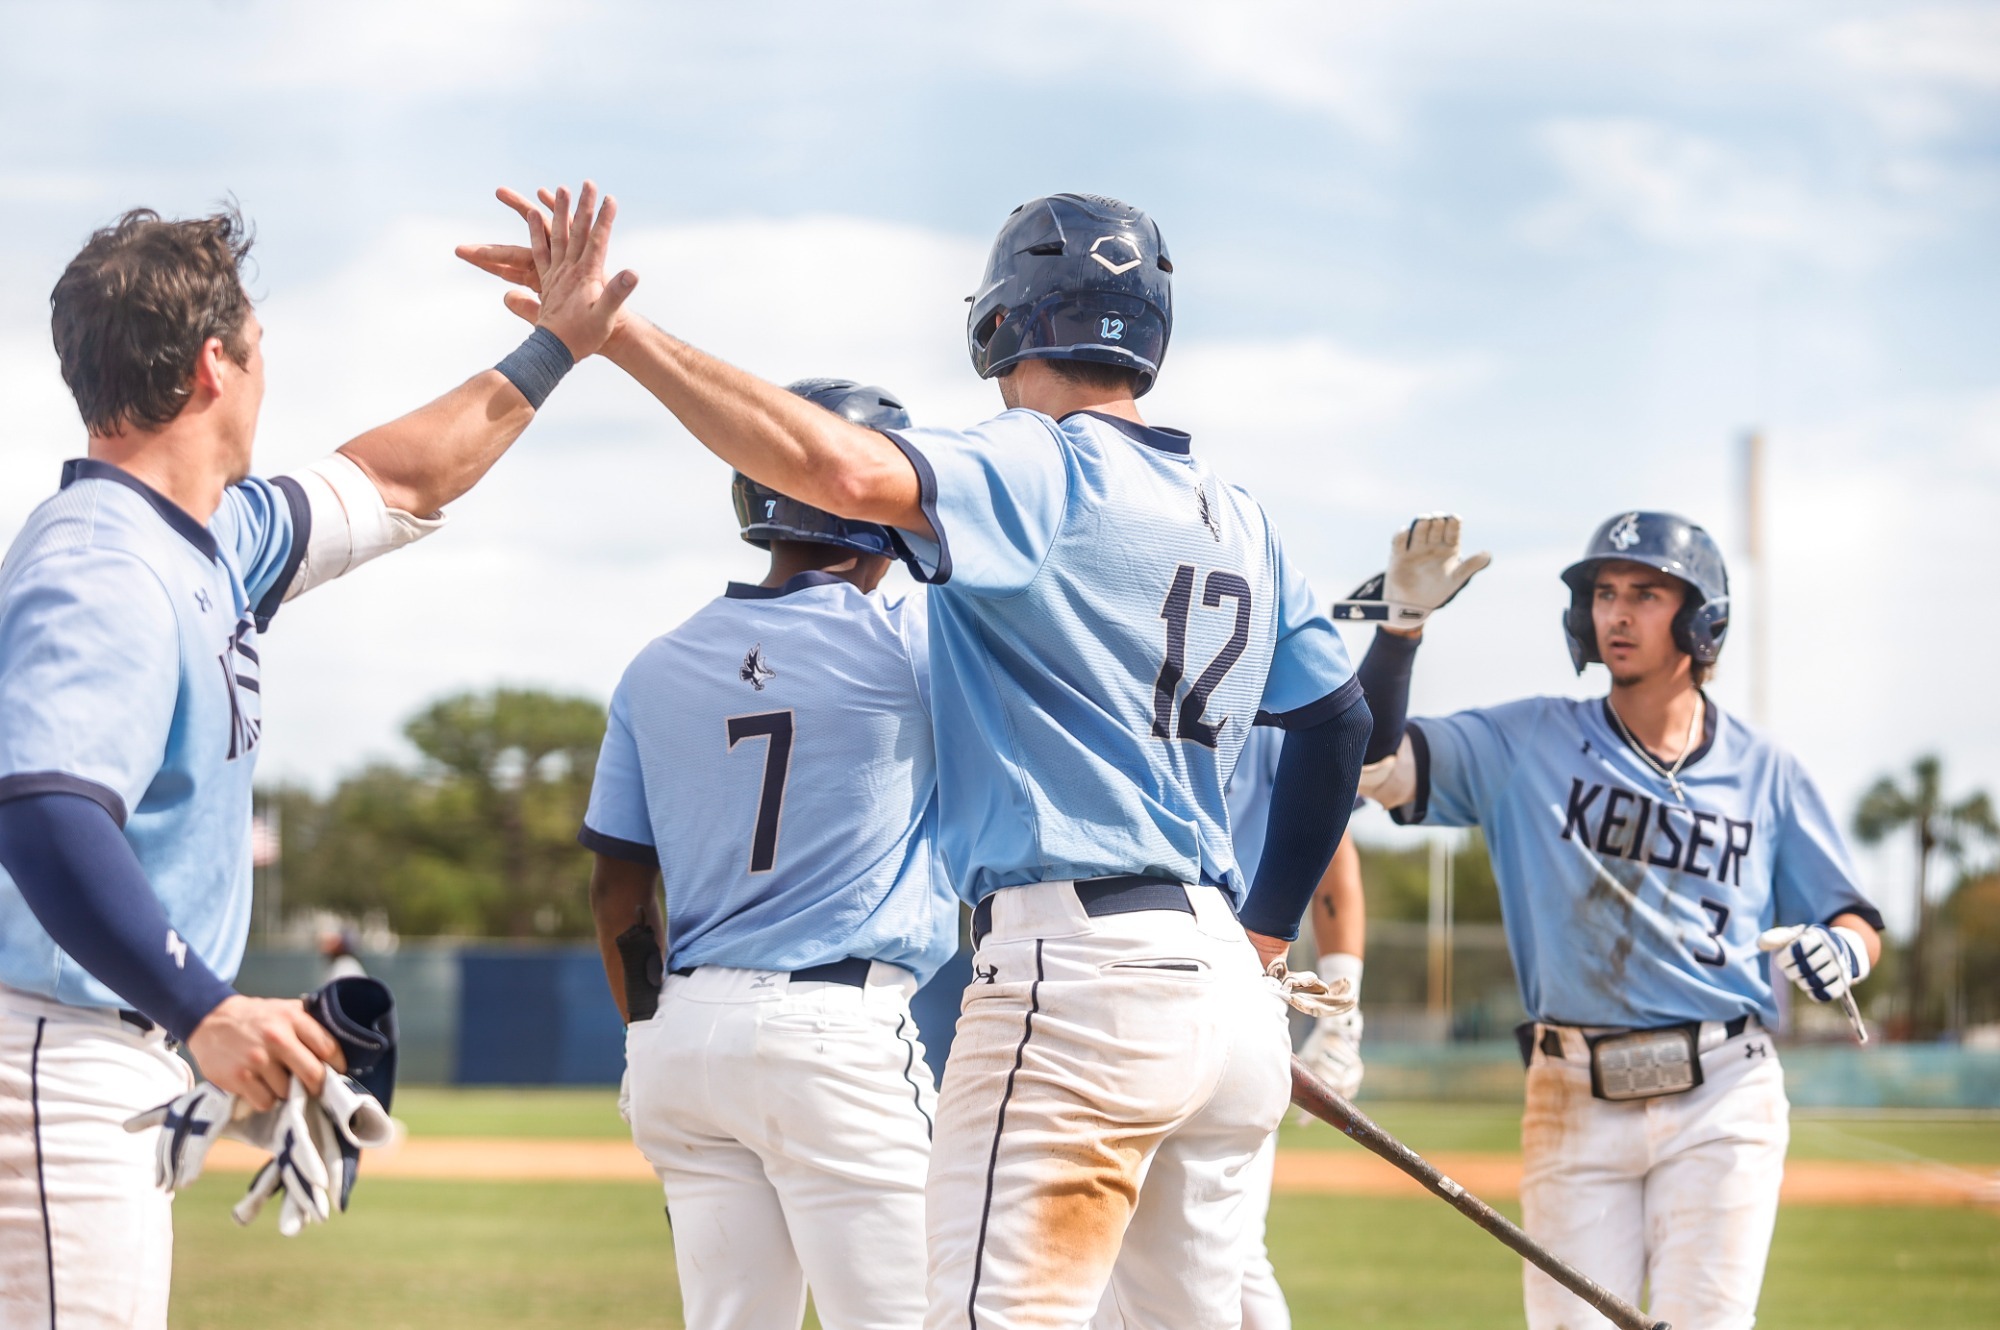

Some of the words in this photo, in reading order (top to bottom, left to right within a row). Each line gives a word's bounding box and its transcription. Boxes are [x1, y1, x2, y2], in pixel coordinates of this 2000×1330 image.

[1100, 317, 1124, 340] 12
[764, 499, 777, 519] 7
[1151, 563, 1252, 750] 12
[726, 709, 795, 875] 7
[1561, 777, 1753, 887] KEISER
[1693, 897, 1730, 967] 3
